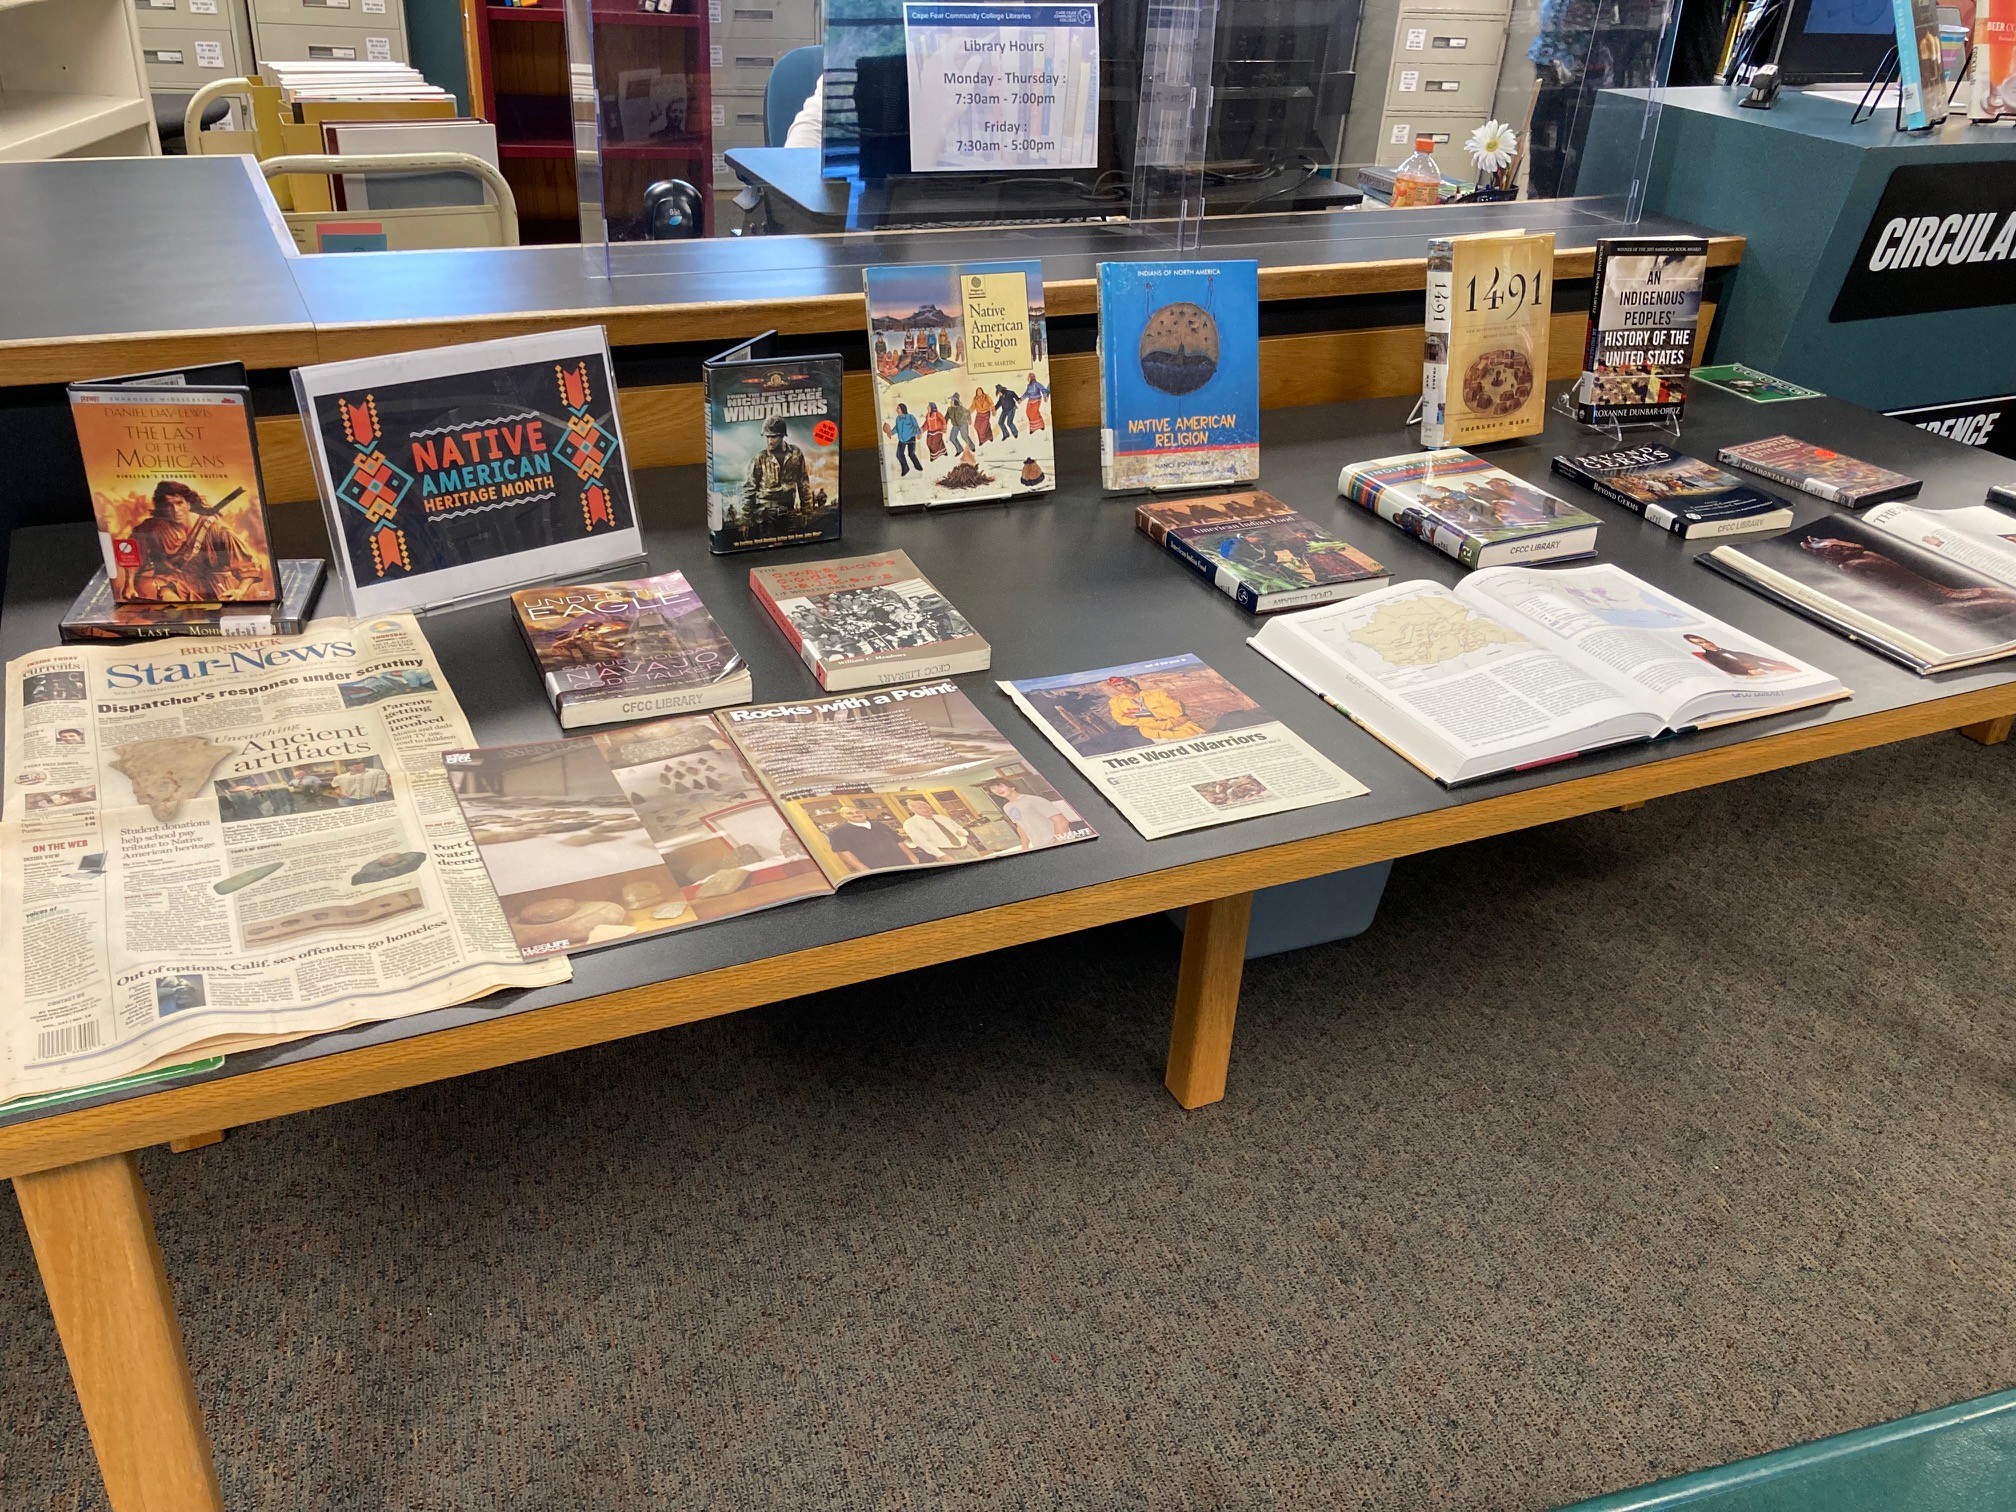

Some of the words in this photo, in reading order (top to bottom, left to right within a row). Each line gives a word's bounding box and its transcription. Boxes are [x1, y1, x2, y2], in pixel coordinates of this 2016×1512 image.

[911, 12, 929, 20] Cape
[945, 12, 980, 20] Community
[981, 12, 1004, 20] College
[1987, 22, 2005, 31] BEER
[964, 40, 1006, 54] Library
[1010, 40, 1045, 52] Hours
[944, 73, 994, 87] Monday
[1006, 73, 1059, 87] Thursday
[955, 93, 1000, 105] 7:30am
[1011, 93, 1056, 108] 7:00pm
[984, 122, 1021, 135] Friday
[956, 140, 1000, 152] 7:30am
[1011, 140, 1055, 154] 5:00pm
[1646, 270, 1661, 285] AN
[1465, 266, 1543, 321] 1491
[1619, 291, 1686, 306] INDIGENOUS
[969, 302, 1006, 318] Native
[1433, 282, 1450, 323] 1491
[971, 318, 1024, 334] American
[1624, 311, 1675, 326] PEOPLES'
[972, 333, 1017, 353] Religion
[1604, 330, 1650, 346] HISTORY
[1652, 330, 1667, 345] OF
[1669, 330, 1690, 345] THE
[974, 361, 986, 369] JOEL
[1605, 350, 1644, 366] UNITED
[1646, 350, 1685, 365] STATES
[727, 394, 786, 407] NICOLAS
[788, 391, 823, 402] CAGE
[105, 407, 148, 418] DANIEL
[723, 398, 828, 423] WINDTALKERS
[1594, 407, 1627, 418] ROXANNE
[1128, 418, 1171, 434] NATIVE
[1175, 414, 1236, 431] AMERICAN
[1460, 422, 1496, 432] CHARLES
[124, 425, 160, 440] THE
[163, 426, 206, 440] LAST
[1155, 431, 1209, 448] RELIGION
[146, 442, 160, 452] OF
[165, 442, 187, 452] THE
[411, 421, 547, 474] NATIVE
[1575, 446, 1653, 463] BEYOND
[116, 448, 225, 469] MOHICANS
[1583, 450, 1669, 470] GERMS
[421, 453, 552, 497] AMERICAN
[1368, 464, 1414, 476] INDIAN
[1741, 462, 1785, 483] POCAHONTAS
[501, 476, 555, 496] MONTH
[424, 486, 498, 513] HERITAGE
[1593, 482, 1617, 500] BEYOND
[1617, 494, 1639, 512] GERMS
[1873, 508, 1900, 525] THE
[1192, 523, 1240, 535] American
[1240, 518, 1269, 529] Indian
[1717, 525, 1735, 533] CFCC
[1736, 519, 1764, 531] LIBRARY
[1510, 545, 1531, 555] CFCC
[1532, 540, 1562, 553] LIBRARY
[523, 591, 623, 608] UNDER
[631, 581, 686, 598] THE
[790, 586, 826, 595] WORLD
[527, 592, 691, 622] EAGLE
[137, 628, 171, 637] LAST
[179, 638, 281, 656] BRUNSWICK
[106, 641, 357, 689] Star-News
[562, 658, 637, 671] SAMUEL
[641, 645, 713, 660] HOLIDAY
[837, 658, 865, 666] William
[23, 662, 80, 677] currents
[566, 651, 718, 683] NAVAJO
[924, 663, 951, 676] CFCC
[574, 675, 639, 690] CODE
[641, 661, 722, 681] TALKER
[877, 669, 922, 684] LIBRARY
[97, 691, 216, 714] Dispatcher's
[219, 677, 299, 698] response
[303, 672, 352, 683] under
[356, 658, 424, 677] scrutiny
[382, 699, 433, 711] Parents
[622, 701, 653, 713] CFCC
[656, 694, 704, 709] LIBRARY
[728, 703, 813, 722] Rocks
[813, 697, 871, 713] with
[872, 694, 892, 705] a
[384, 705, 432, 720] getting
[387, 714, 422, 725] more
[389, 715, 445, 732] involved
[214, 722, 302, 744] Unearthing
[240, 725, 369, 756] Ancient
[234, 741, 371, 773] artifacts
[1102, 756, 1140, 769] The
[1138, 745, 1190, 762] Word
[1187, 733, 1268, 753] Warriors
[120, 824, 160, 836] Student
[161, 820, 211, 831] donations
[121, 834, 143, 845] help
[144, 830, 177, 842] school
[178, 830, 196, 839] pay
[122, 841, 157, 852] tribute
[171, 835, 204, 845] Native
[32, 844, 46, 853] ON
[47, 842, 66, 852] THE
[67, 839, 88, 849] WEB
[122, 847, 173, 859] American
[175, 841, 216, 852] heritage
[432, 843, 464, 851] Port
[435, 849, 475, 859] water
[116, 970, 145, 986] Out
[148, 964, 166, 976] of
[166, 964, 228, 974] options,
[230, 961, 270, 972] Calif.
[273, 954, 296, 965] sex
[298, 942, 366, 959] offenders
[367, 939, 384, 950] go
[386, 919, 448, 944] homeless
